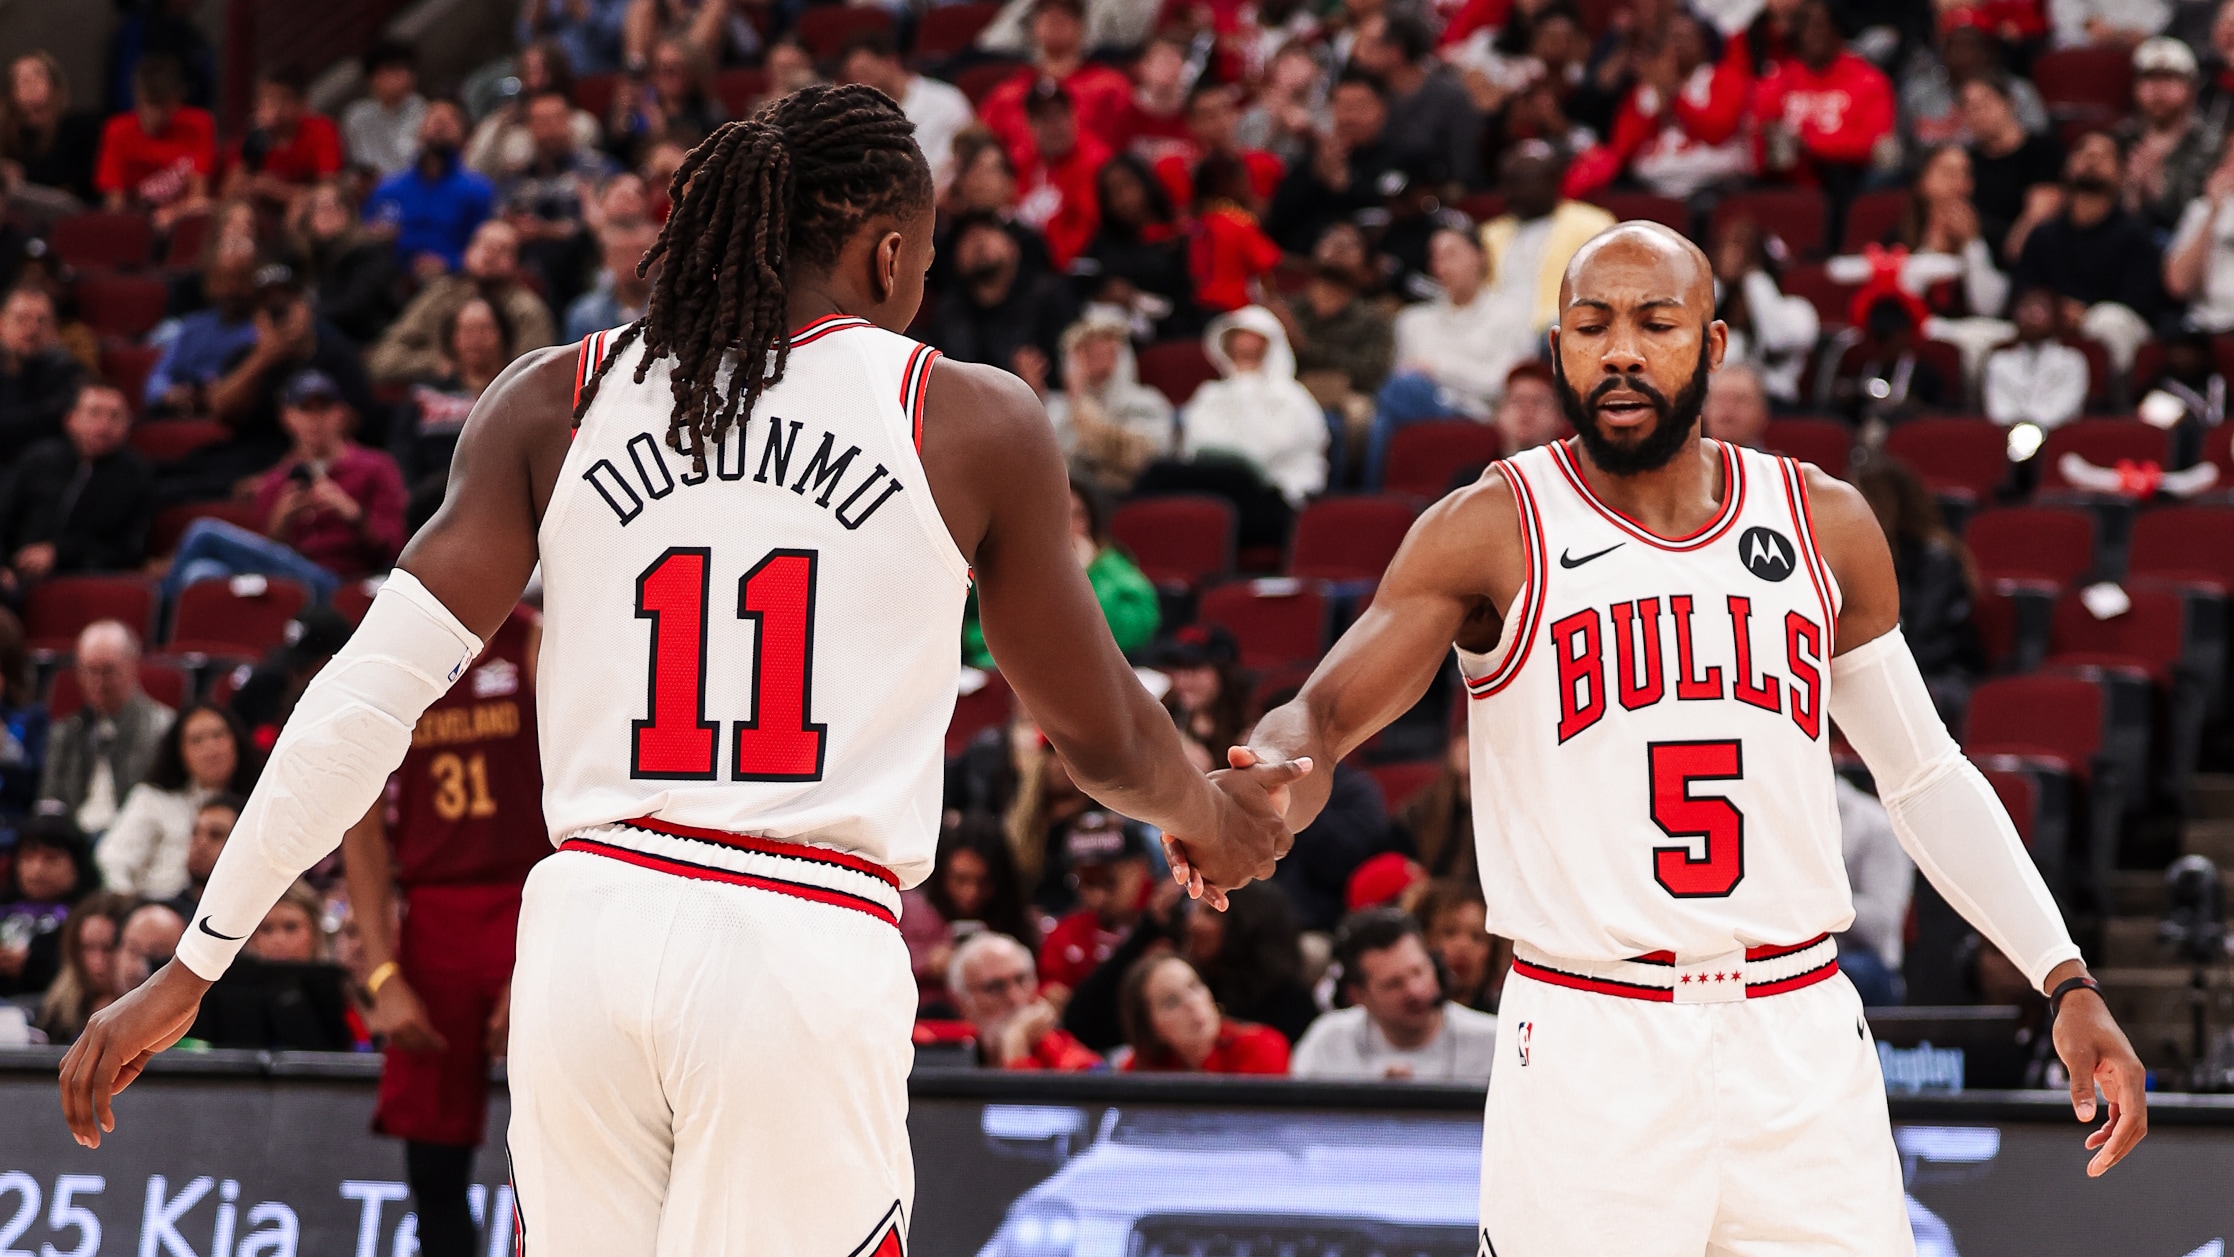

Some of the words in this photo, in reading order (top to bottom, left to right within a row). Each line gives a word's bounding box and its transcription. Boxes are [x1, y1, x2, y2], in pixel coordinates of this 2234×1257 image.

[582, 414, 903, 530] DOSUNMU
[630, 546, 828, 782] 11
[1550, 594, 1822, 746] BULLS
[411, 702, 520, 748] LEVELAND
[431, 753, 498, 823] 31
[1647, 738, 1745, 899] 5
[137, 1174, 300, 1257] Kia
[338, 1180, 515, 1257] Tl
